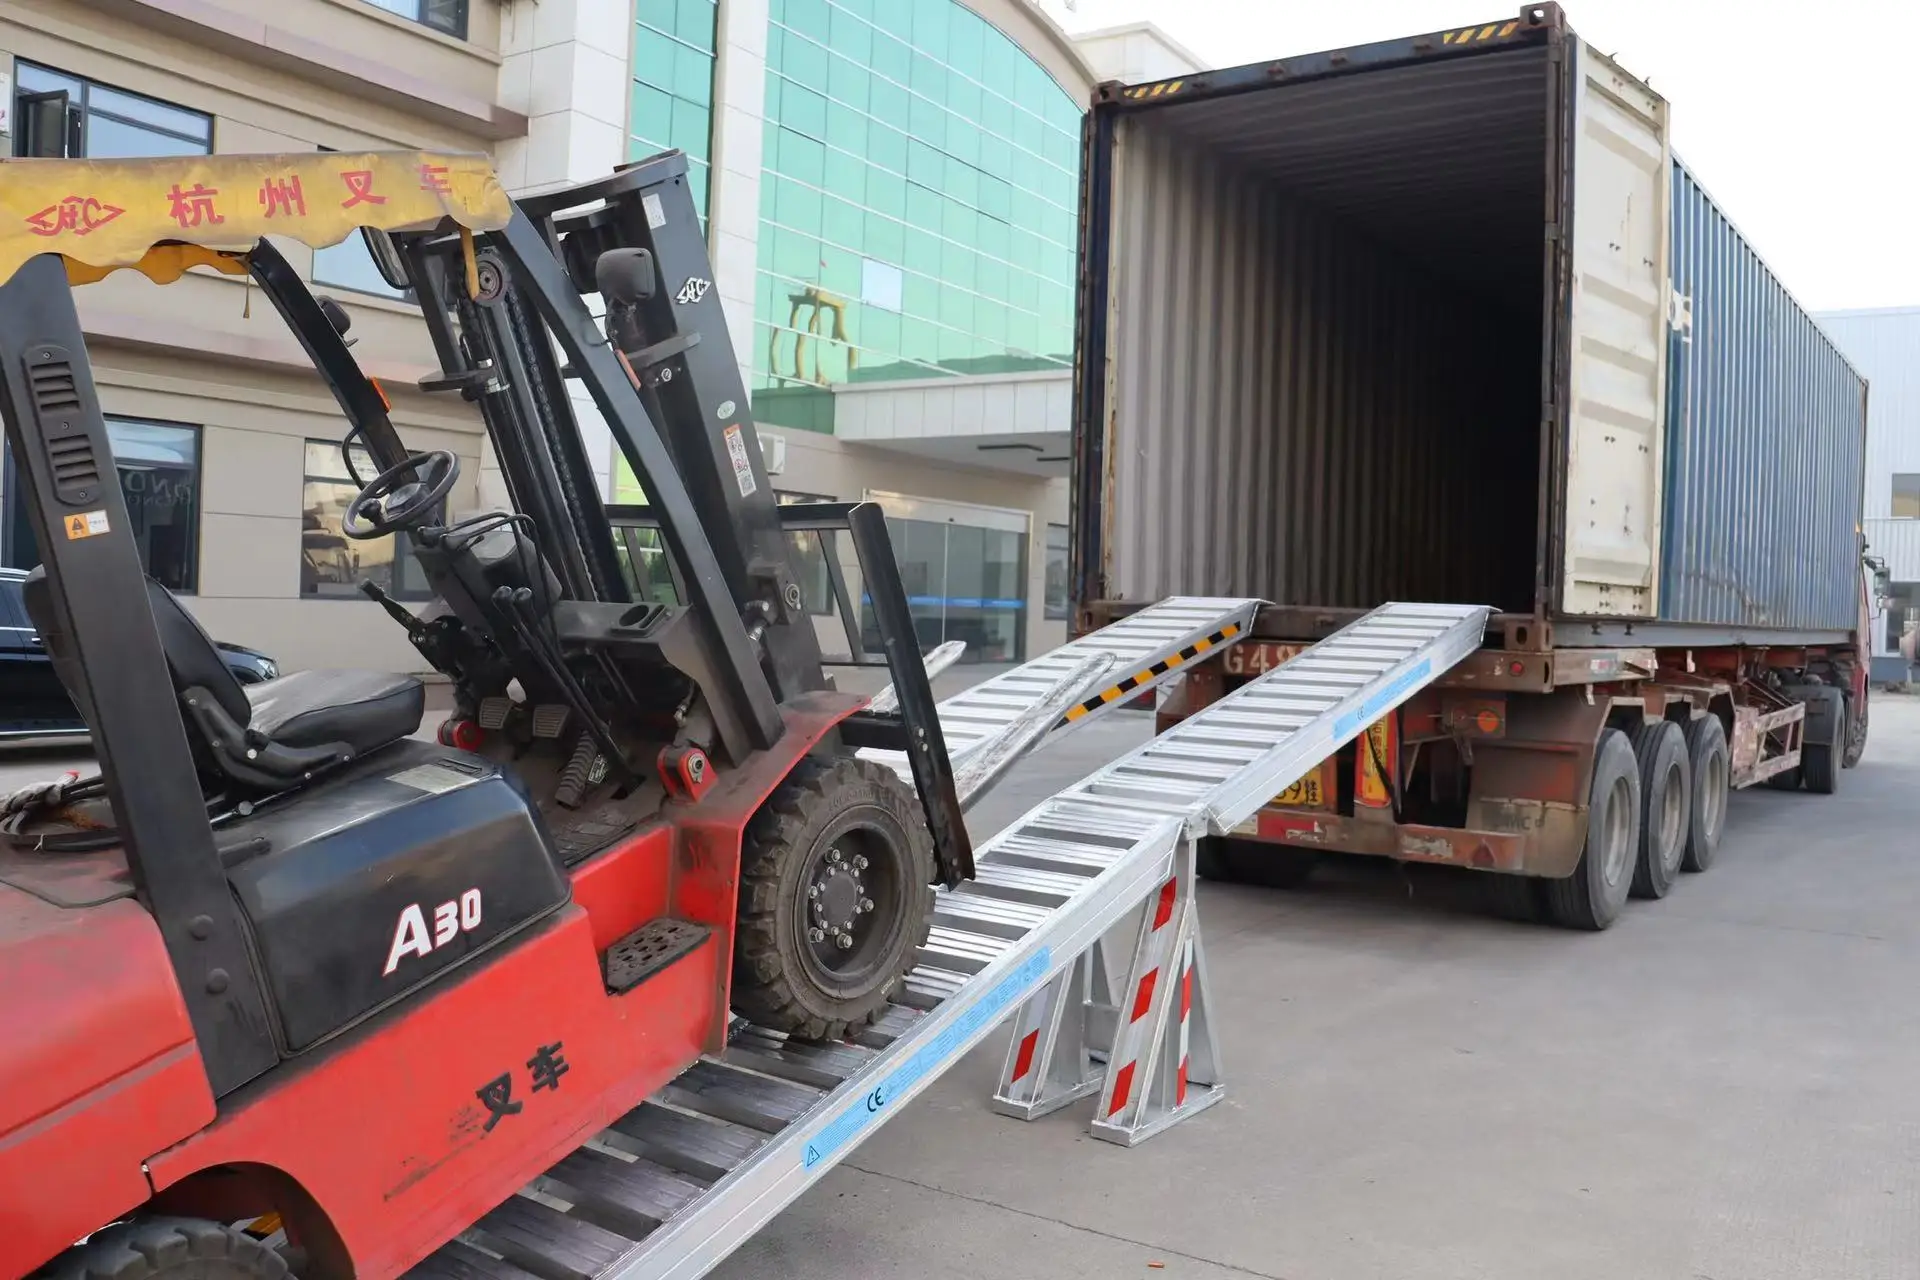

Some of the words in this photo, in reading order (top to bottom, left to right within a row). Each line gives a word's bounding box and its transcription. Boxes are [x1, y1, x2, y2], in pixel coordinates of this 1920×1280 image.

[382, 887, 482, 977] A30
[475, 1040, 570, 1133] 叉车
[867, 1087, 885, 1113] CE
